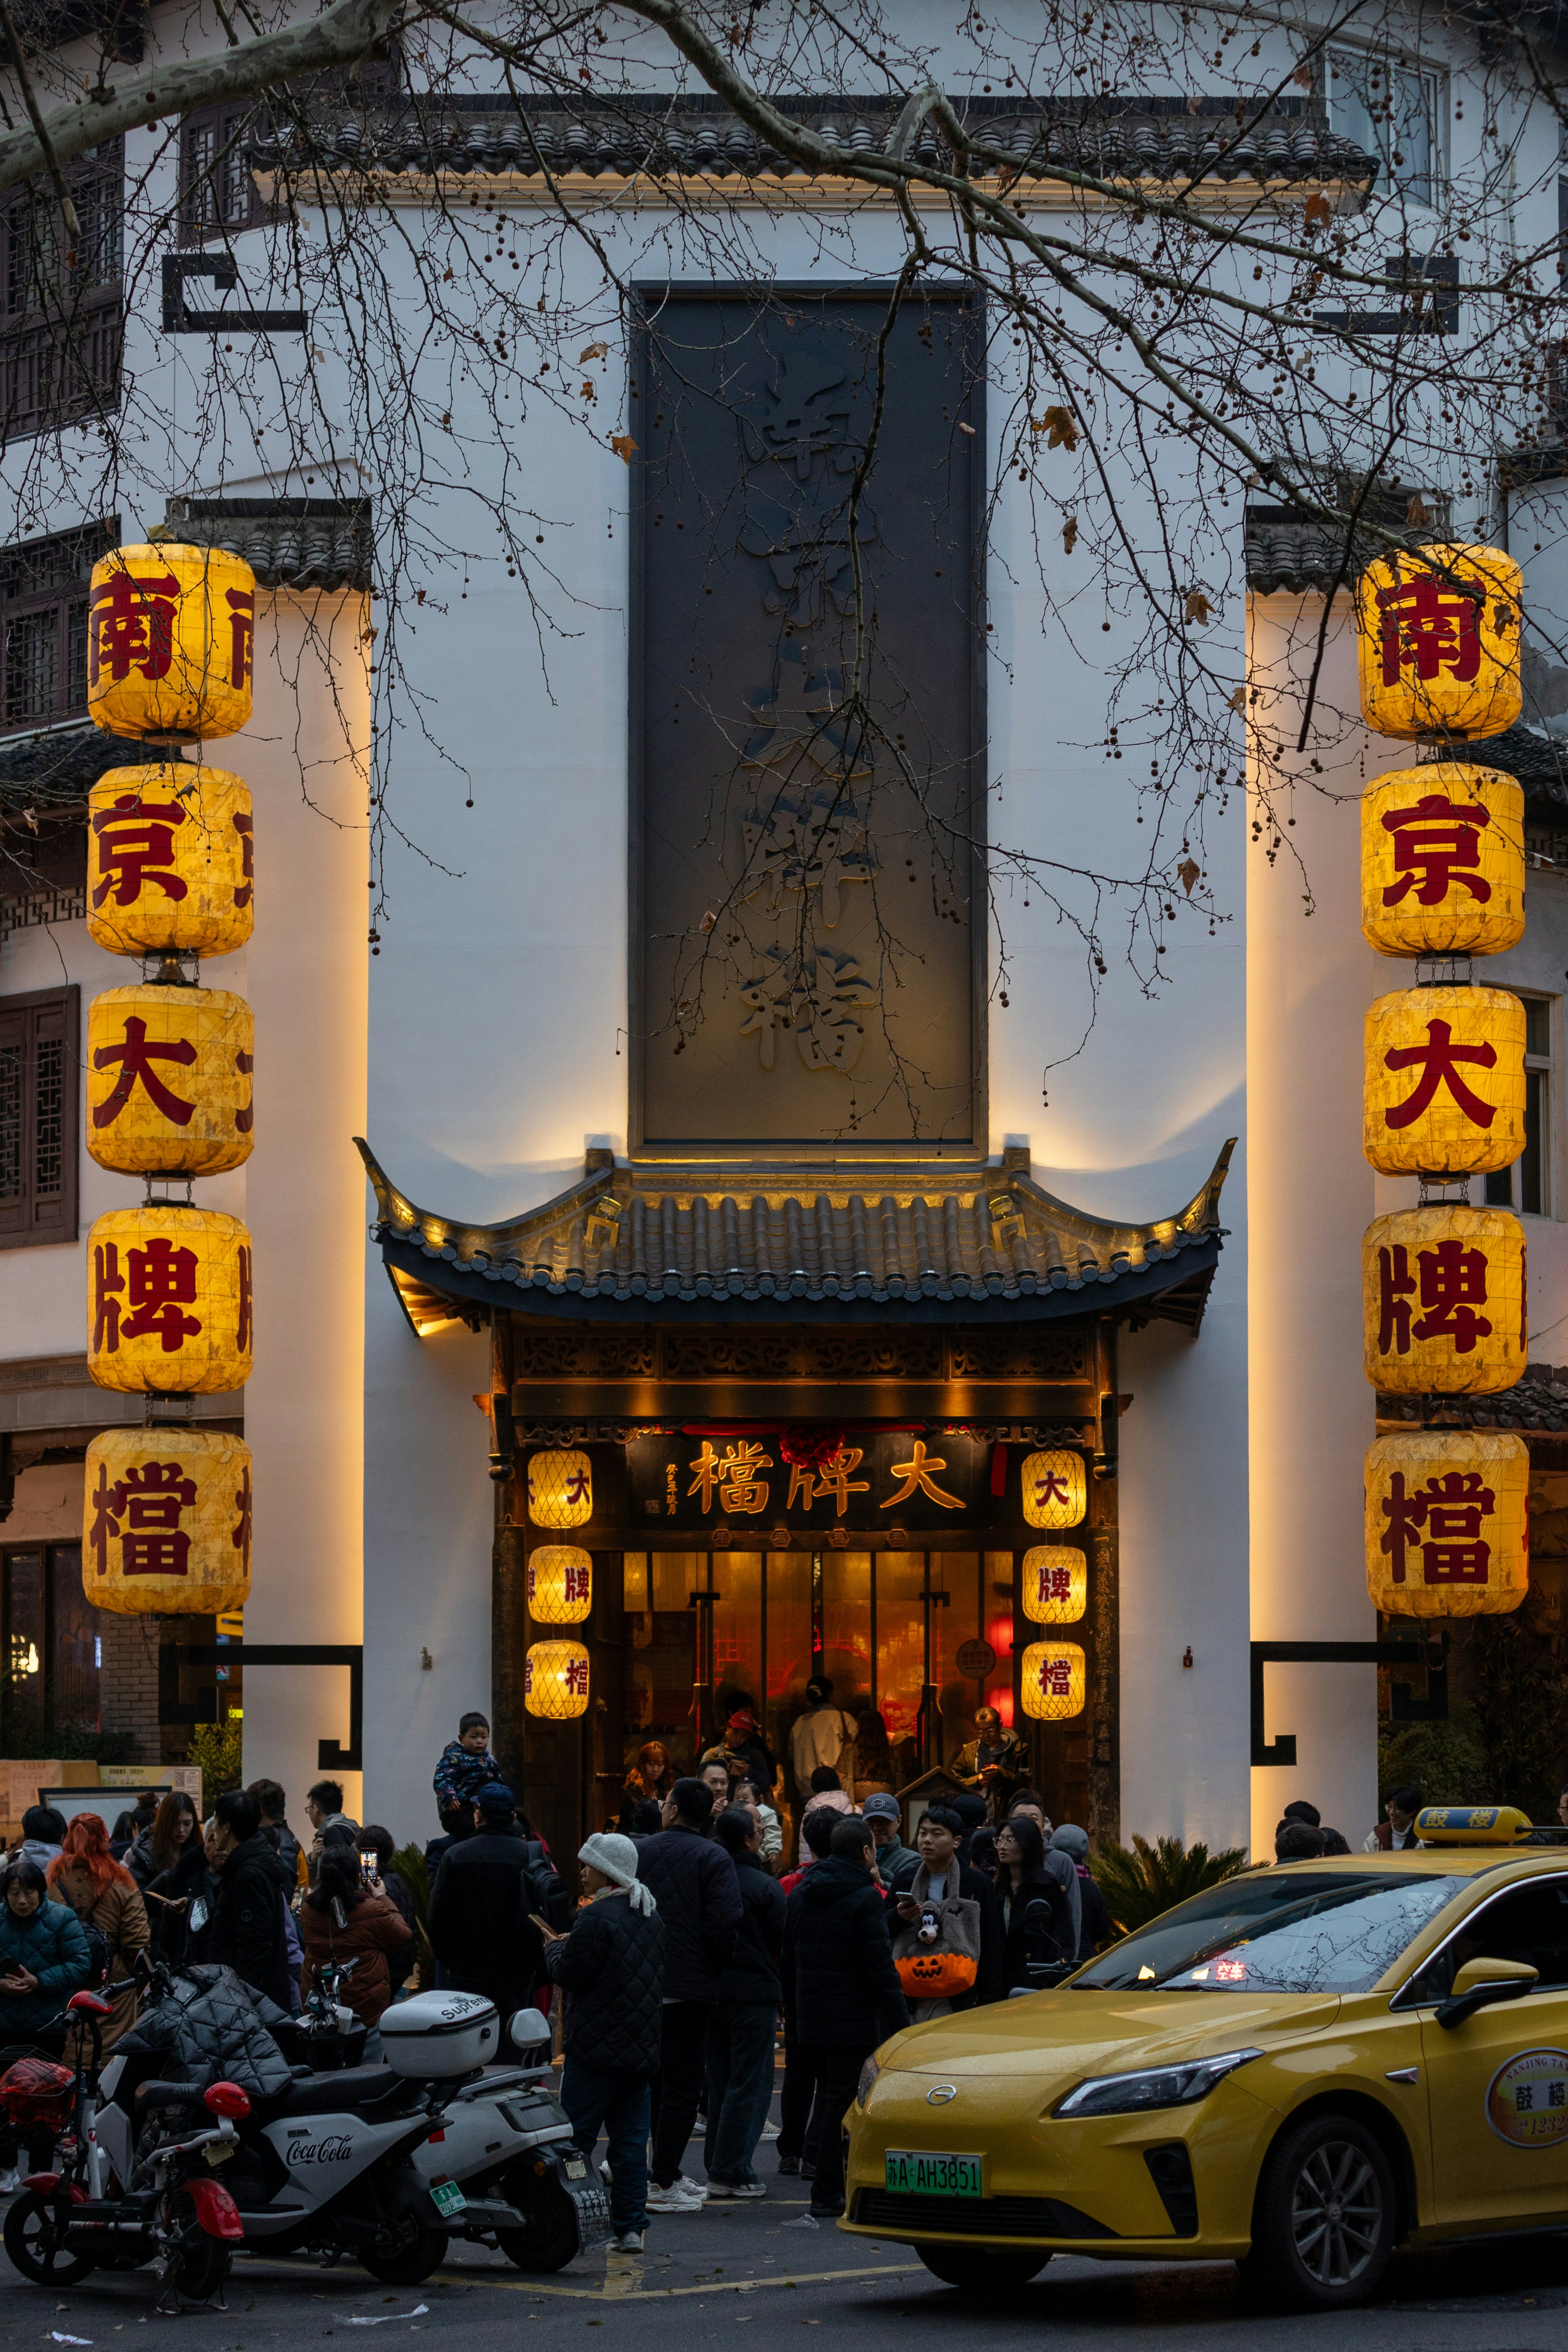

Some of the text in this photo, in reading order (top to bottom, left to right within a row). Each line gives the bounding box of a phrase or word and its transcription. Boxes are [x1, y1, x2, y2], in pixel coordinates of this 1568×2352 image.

[89, 573, 202, 1577] 南 京 大 牌 檔
[1375, 572, 1498, 1584] 南 京 大 牌 檔
[1424, 1809, 1494, 1829] 鼓楼
[1216, 1961, 1245, 1980] 空车
[441, 1997, 490, 2019] Suprem
[1507, 2057, 1547, 2079] NANJING
[1516, 2082, 1565, 2111] 鼓楼
[286, 2134, 355, 2166] Coca-Cola
